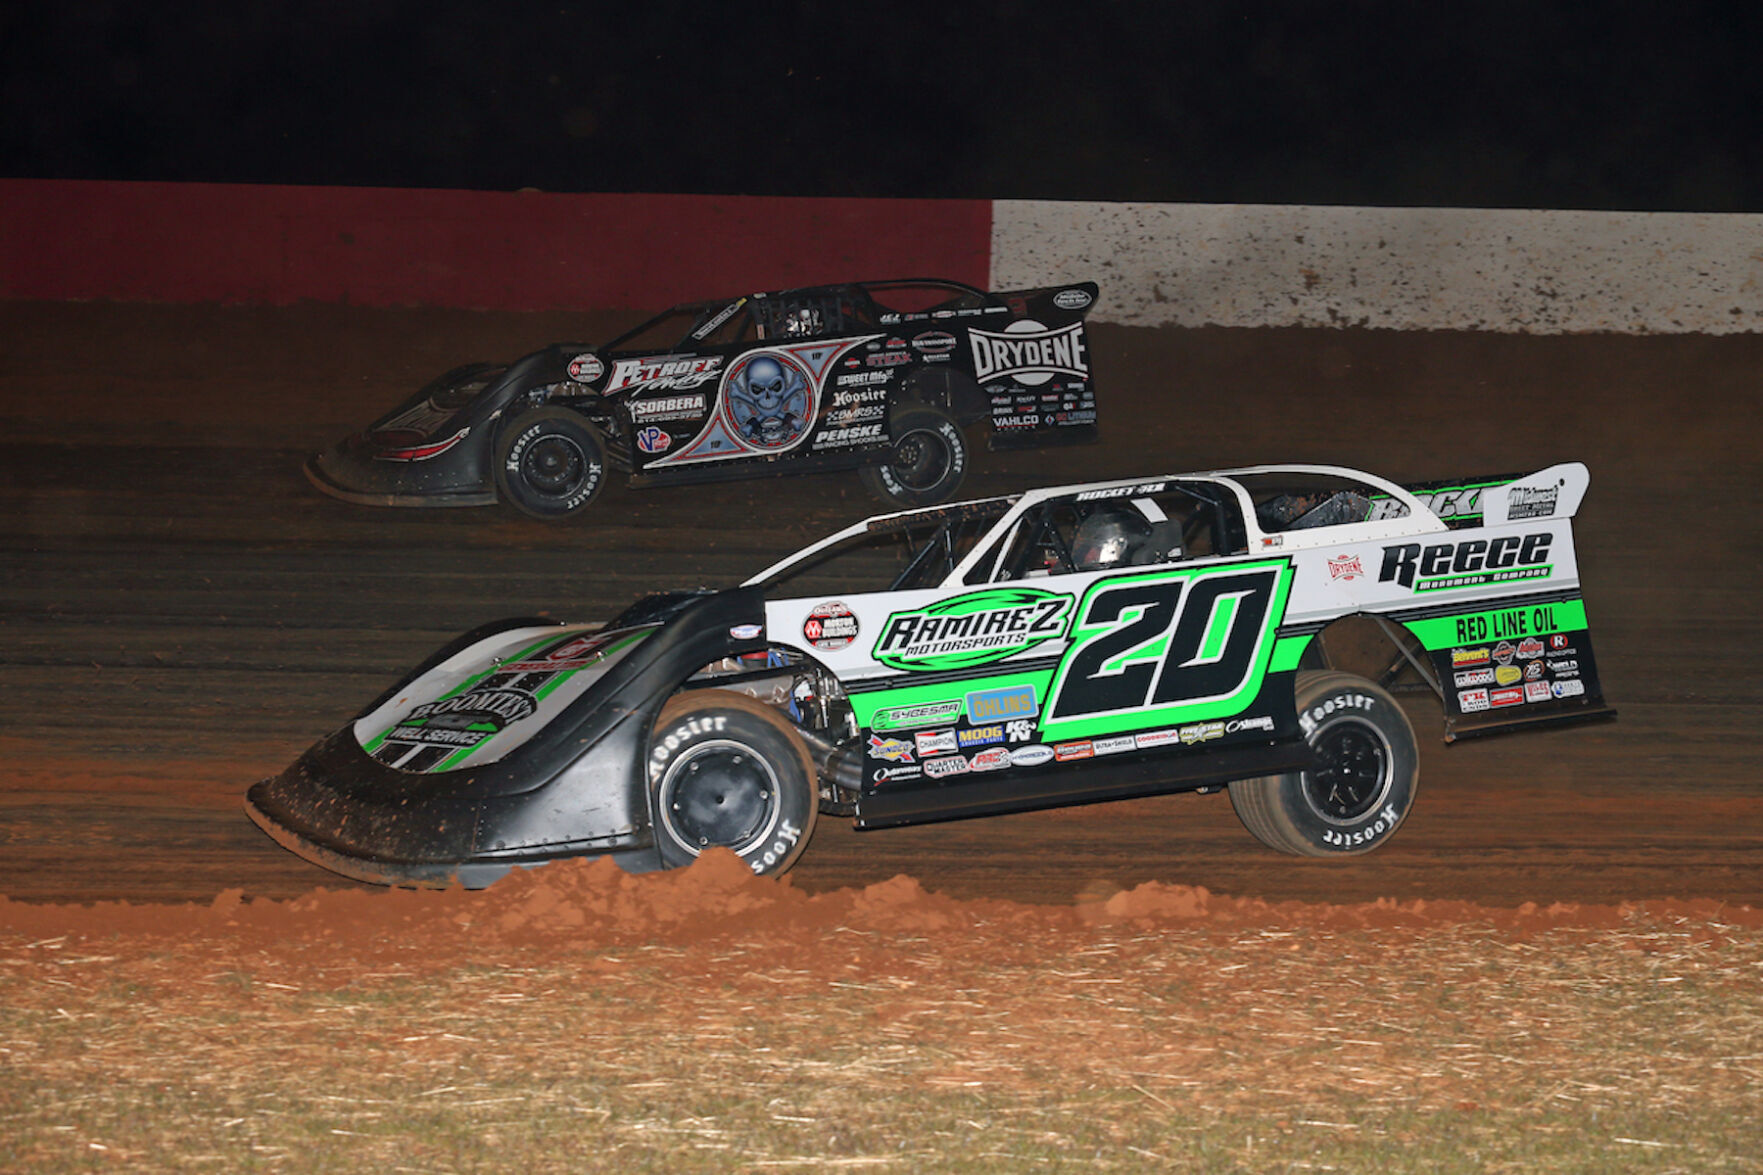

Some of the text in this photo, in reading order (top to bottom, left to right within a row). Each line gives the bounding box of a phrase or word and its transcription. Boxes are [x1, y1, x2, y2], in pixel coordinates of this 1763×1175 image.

[969, 327, 1088, 378] DRYDENE
[604, 356, 723, 395] PETROFF
[637, 396, 703, 414] SORBERA
[832, 387, 886, 406] Hoosier
[993, 415, 1039, 427] VAHLCO
[639, 428, 659, 451] VP
[815, 424, 882, 443] PENSKE
[506, 425, 540, 472] Hoosier
[567, 462, 601, 509] Hoosier
[1328, 557, 1363, 578] DRYDENE
[1456, 607, 1558, 643] RED LINE OIL
[904, 633, 1026, 656] MOTORSPORTS
[1050, 570, 1278, 720] 20
[973, 694, 1031, 717] ÖHLINS
[1299, 694, 1375, 738] Hoosier
[389, 727, 485, 744] WELL SERVICE
[919, 736, 954, 749] CHAMPION
[959, 726, 1003, 742] MOOG
[650, 716, 727, 783] Hoosier
[1323, 802, 1399, 849] Hoosier
